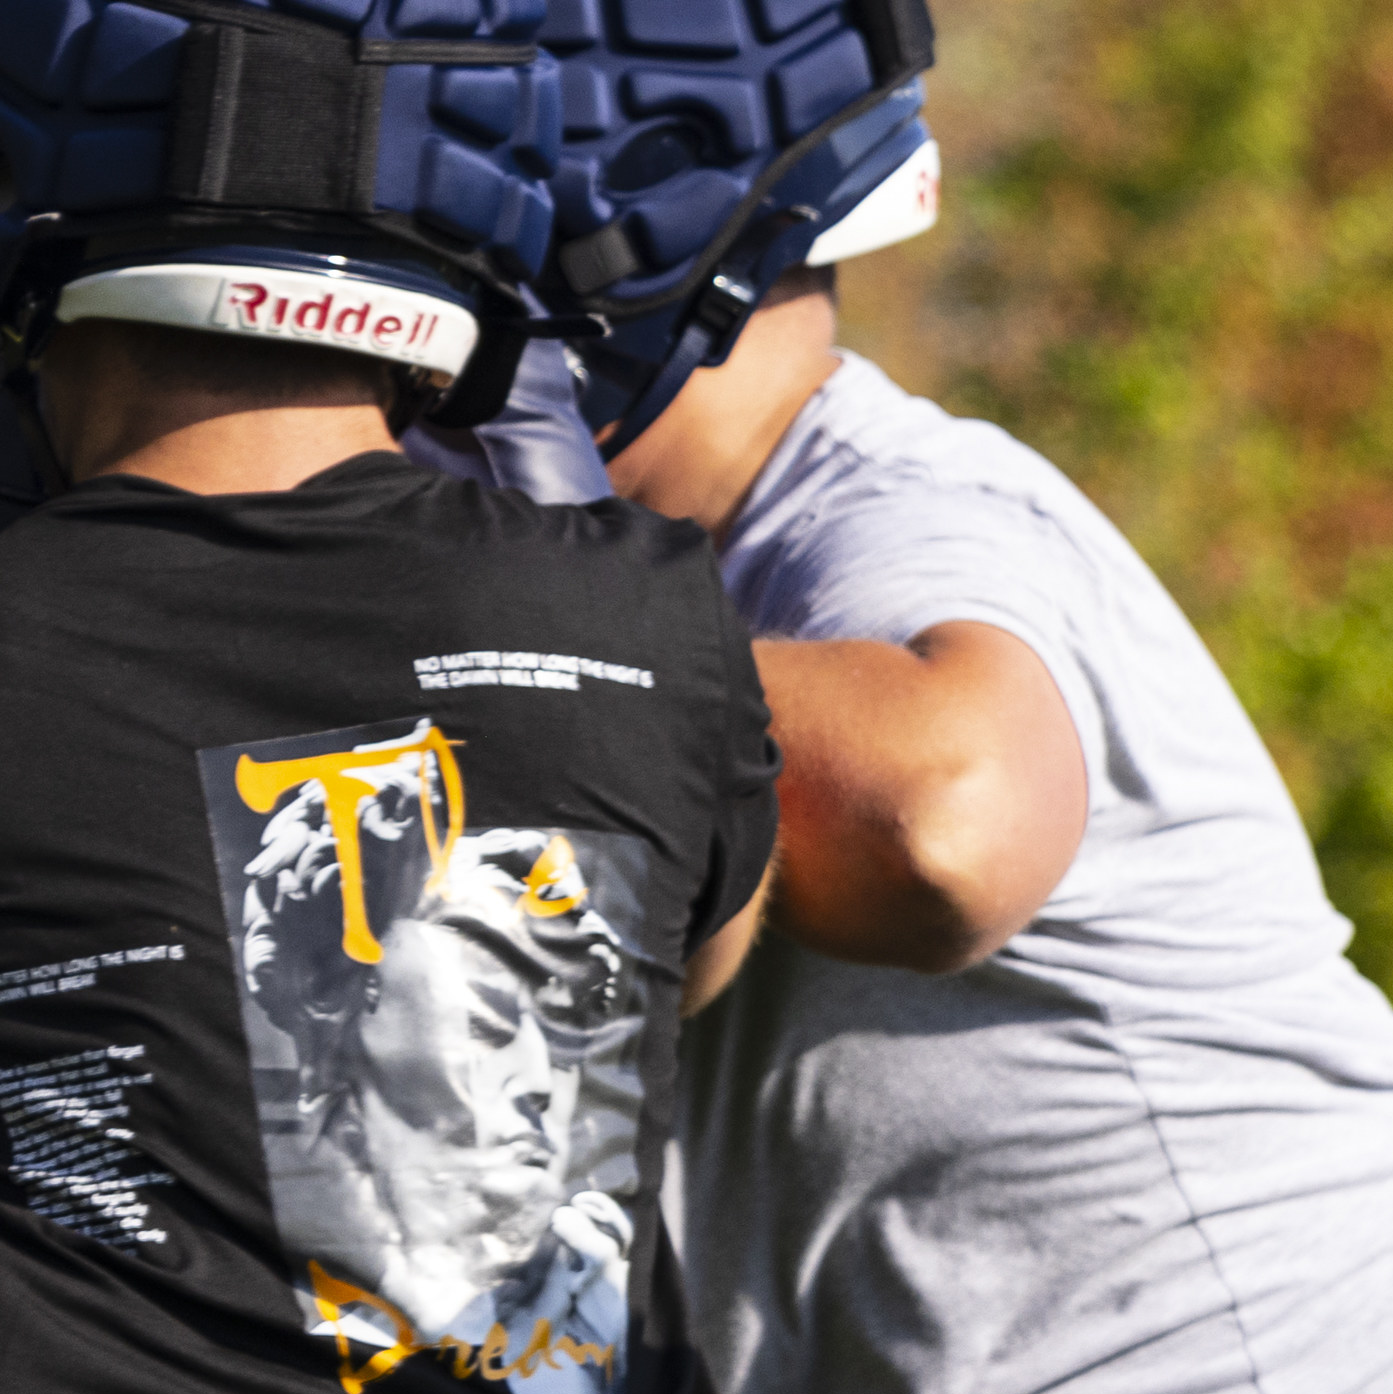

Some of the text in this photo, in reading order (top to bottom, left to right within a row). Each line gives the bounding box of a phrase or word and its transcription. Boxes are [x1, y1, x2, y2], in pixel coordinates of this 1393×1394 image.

[215, 281, 440, 352] Riddell
[414, 656, 440, 674] NO
[441, 651, 499, 670] MATTER
[501, 652, 538, 669] HOW
[539, 653, 579, 674] LONG
[417, 672, 449, 690] THE
[500, 669, 534, 687] WILL
[62, 956, 98, 974] LONG
[99, 951, 125, 967] THE
[125, 945, 168, 963] NIGHT
